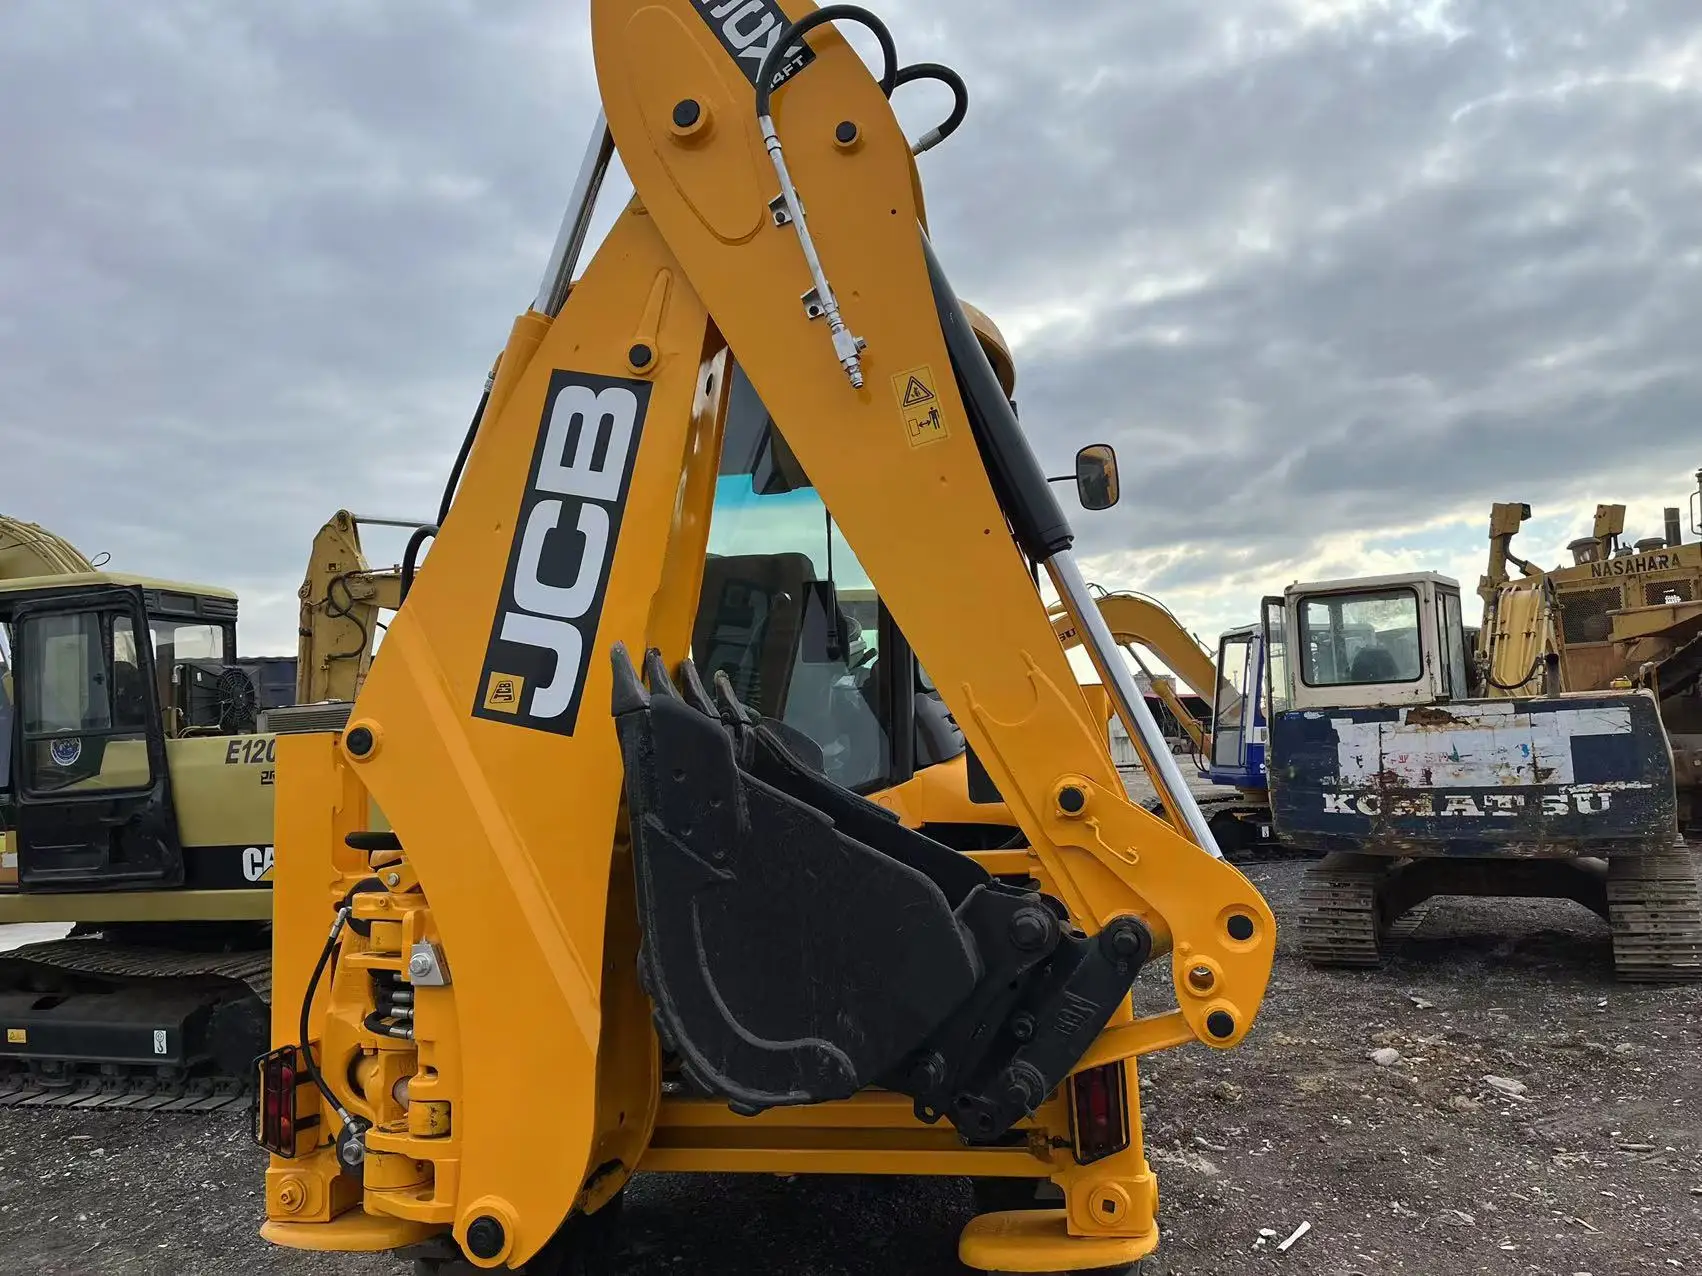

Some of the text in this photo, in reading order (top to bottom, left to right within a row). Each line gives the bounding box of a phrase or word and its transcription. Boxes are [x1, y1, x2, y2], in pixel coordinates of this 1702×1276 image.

[770, 55, 804, 88] 4FT
[500, 385, 638, 718] JCB
[1591, 553, 1680, 577] NASAHARA
[493, 682, 513, 701] JCB
